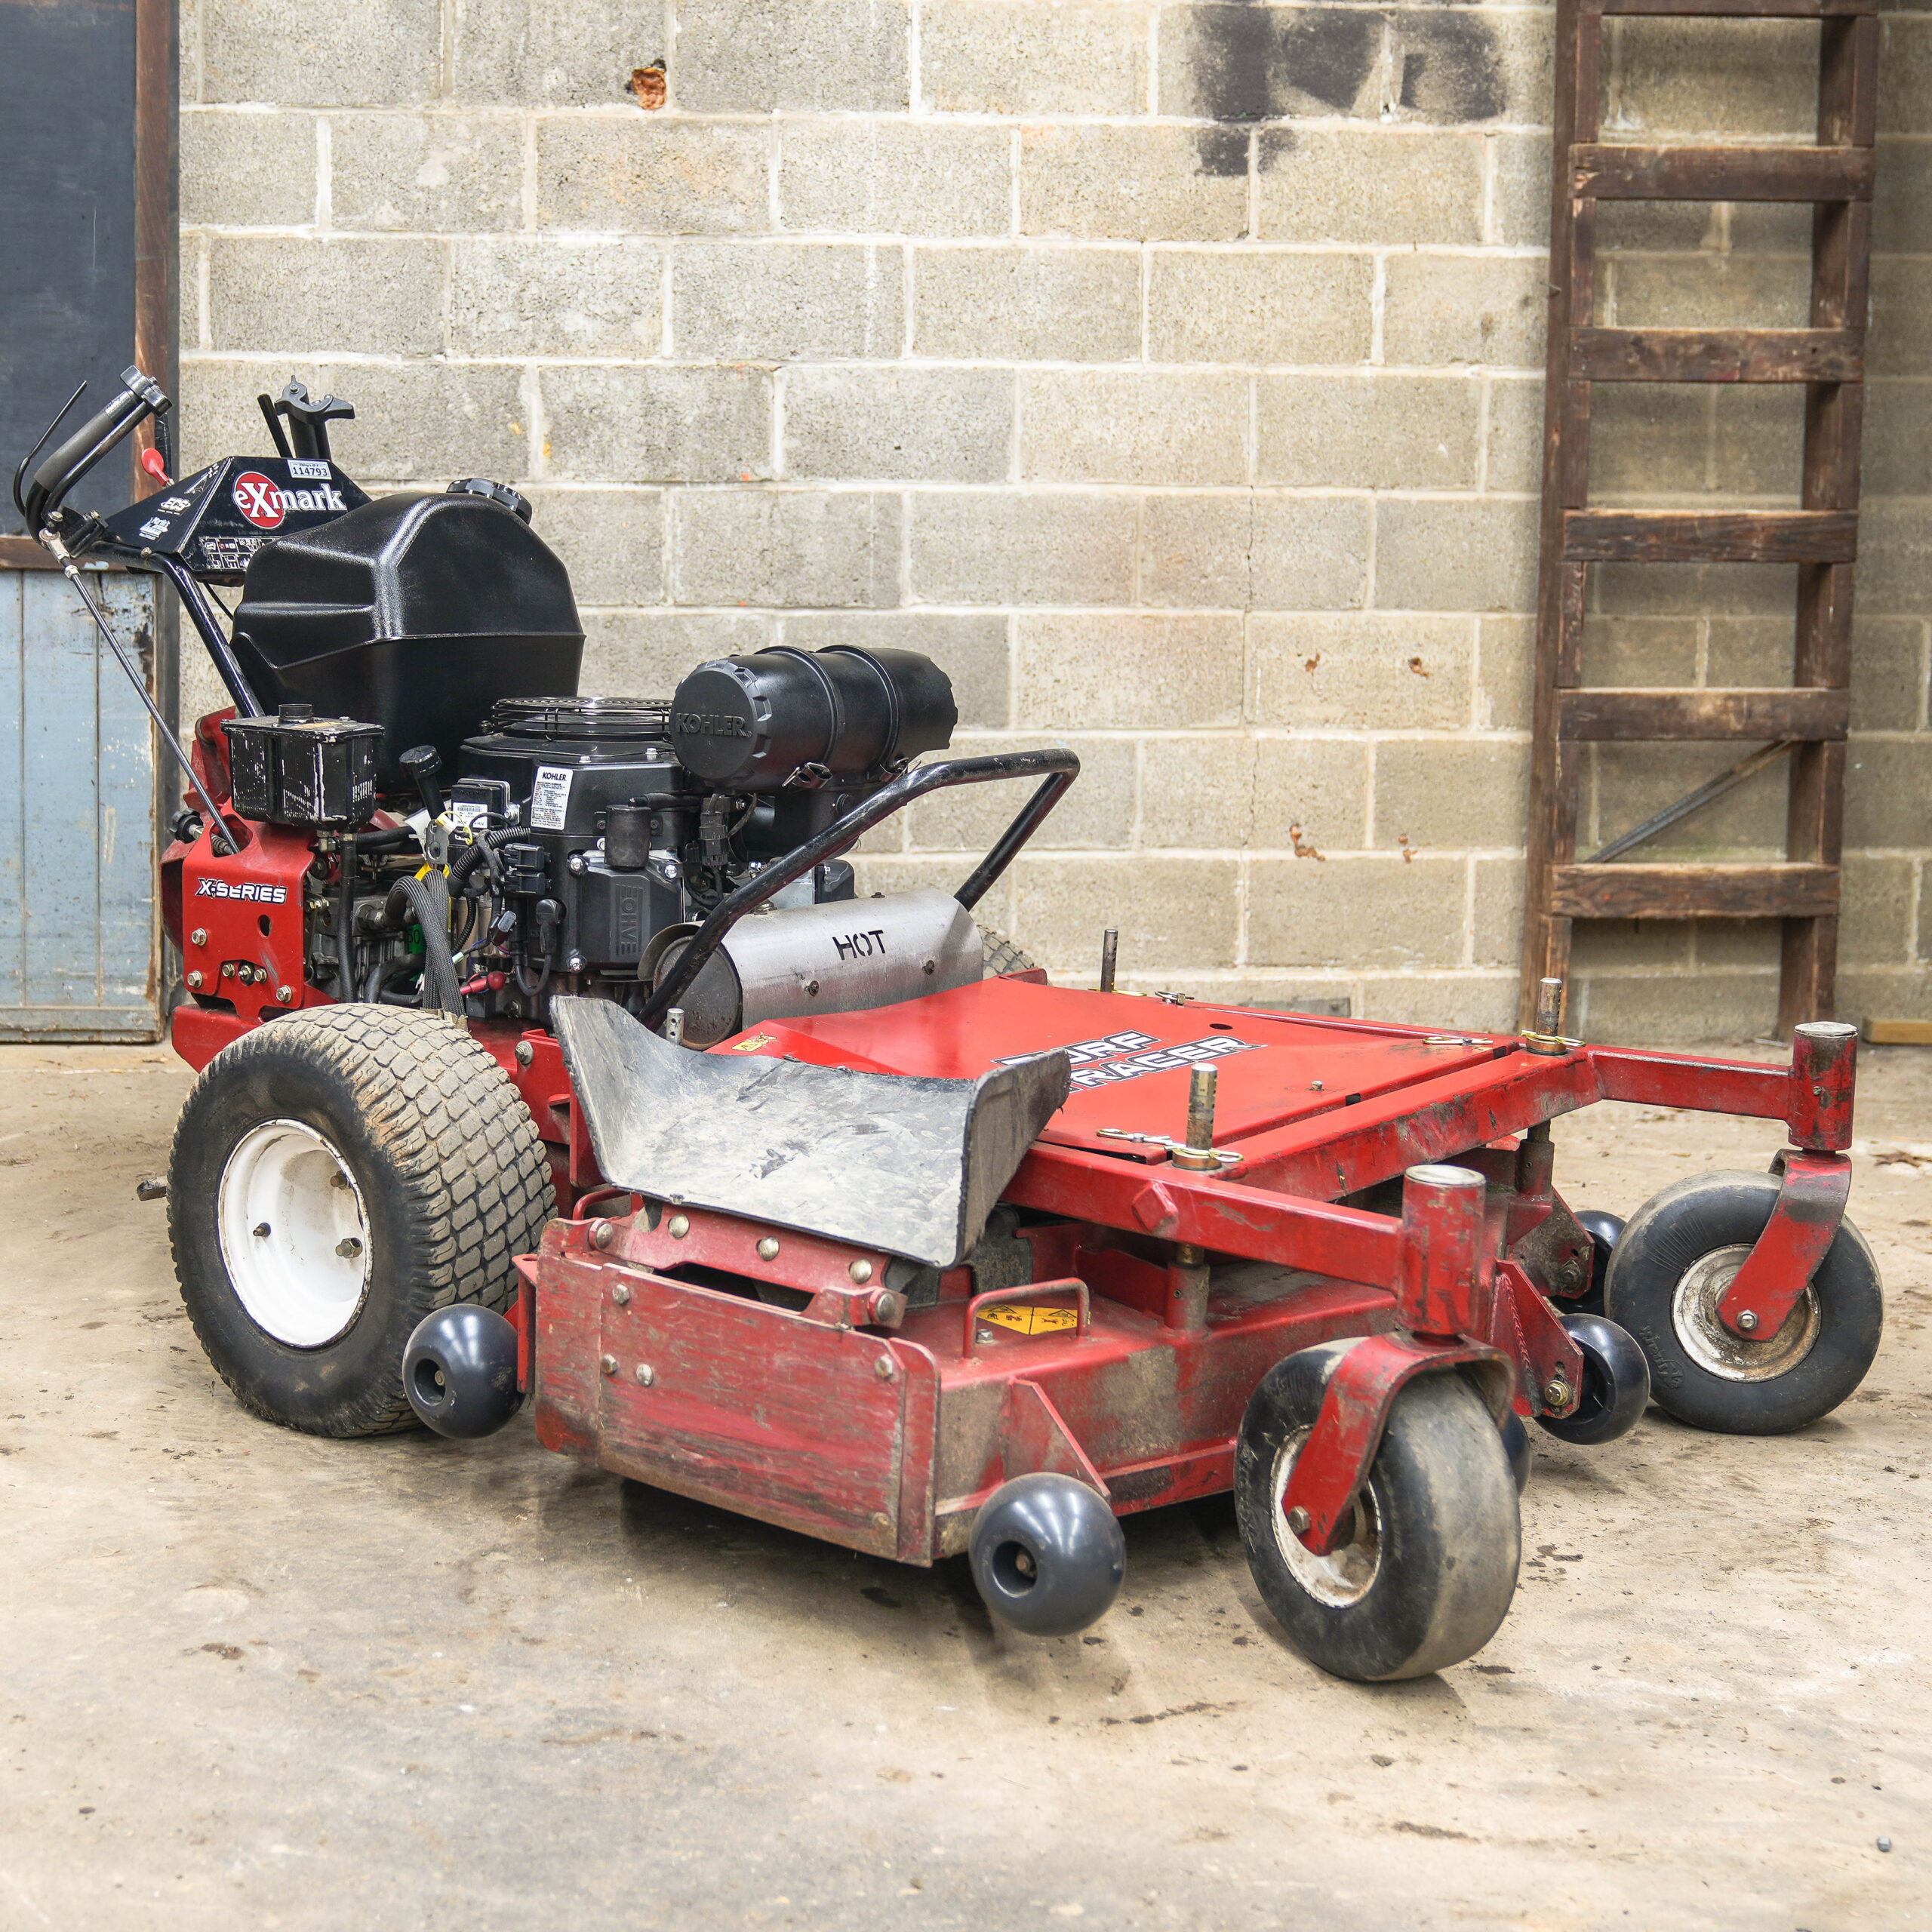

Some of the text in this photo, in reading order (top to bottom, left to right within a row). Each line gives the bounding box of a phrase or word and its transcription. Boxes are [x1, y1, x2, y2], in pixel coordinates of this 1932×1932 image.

[292, 466, 328, 476] 114793
[676, 712, 746, 737] KOHLER
[543, 772, 567, 781] KOHLER
[197, 879, 287, 903] X-SERIES
[832, 929, 886, 961] HOT
[1069, 1036, 1260, 1092] RACER
